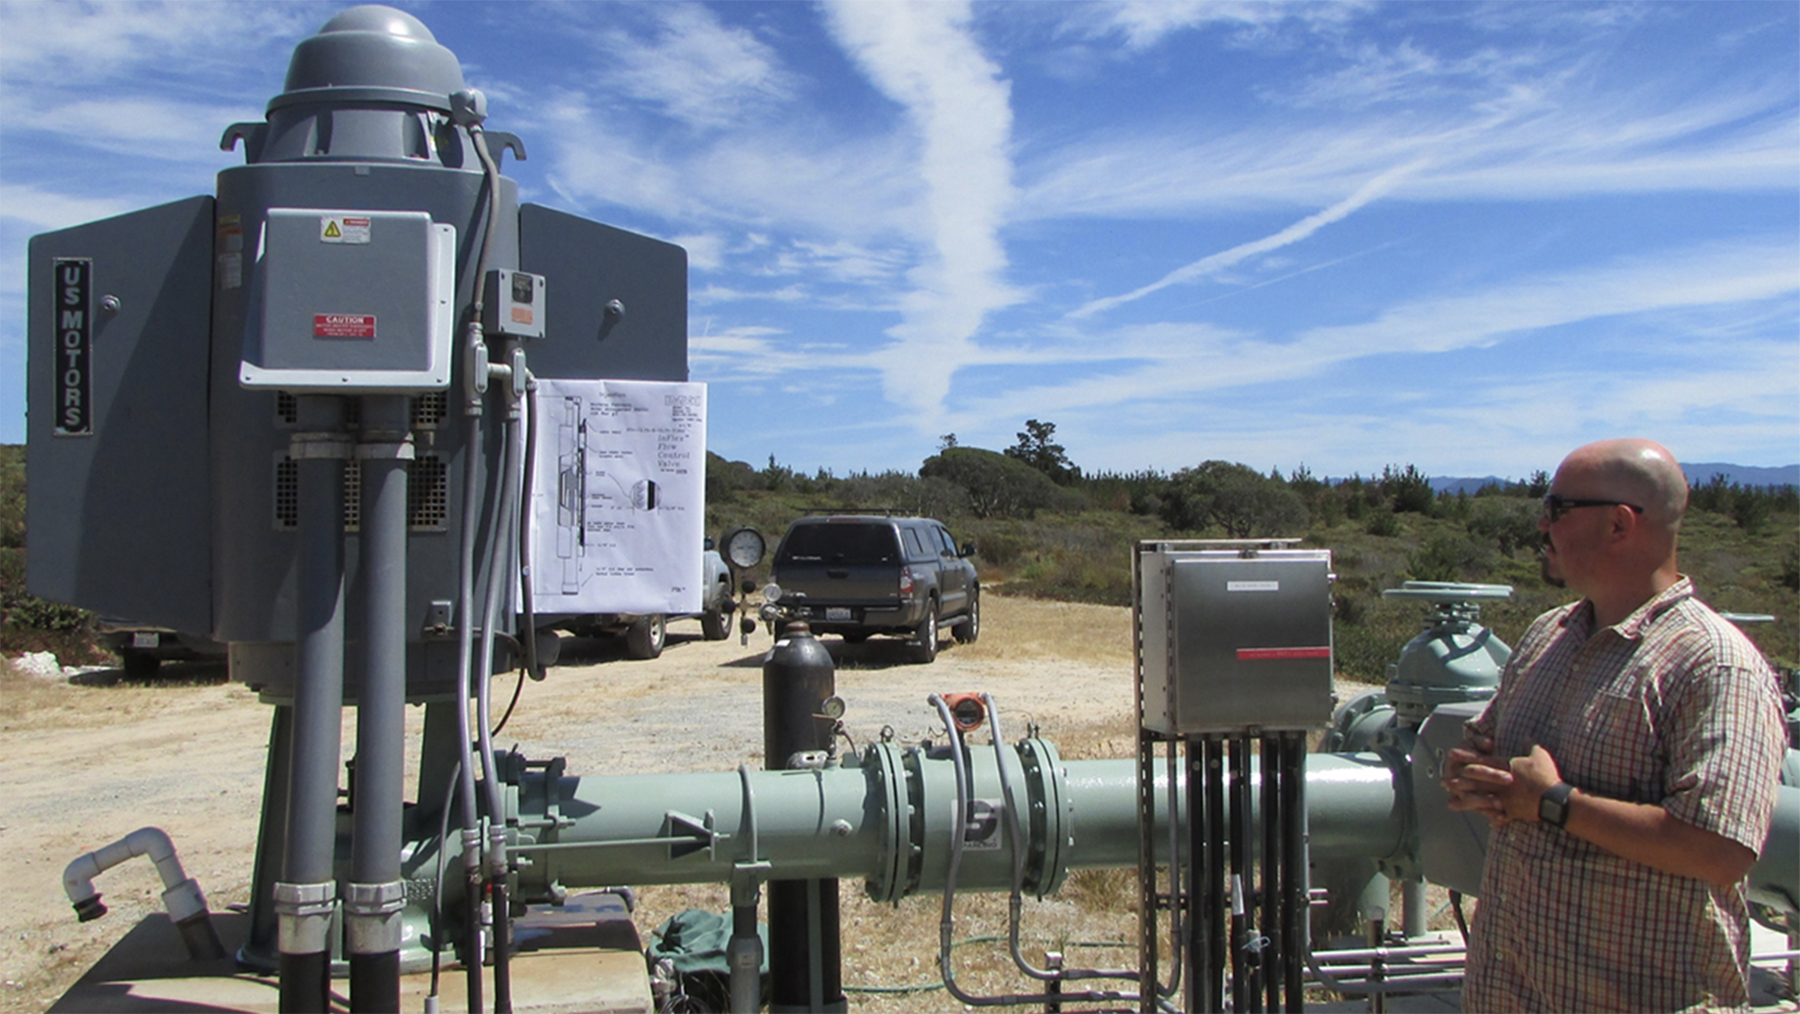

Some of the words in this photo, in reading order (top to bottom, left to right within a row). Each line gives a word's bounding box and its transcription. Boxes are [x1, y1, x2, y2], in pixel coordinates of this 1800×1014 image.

[64, 266, 80, 305] US
[326, 316, 364, 324] CAUTION
[62, 310, 83, 426] MOTORS
